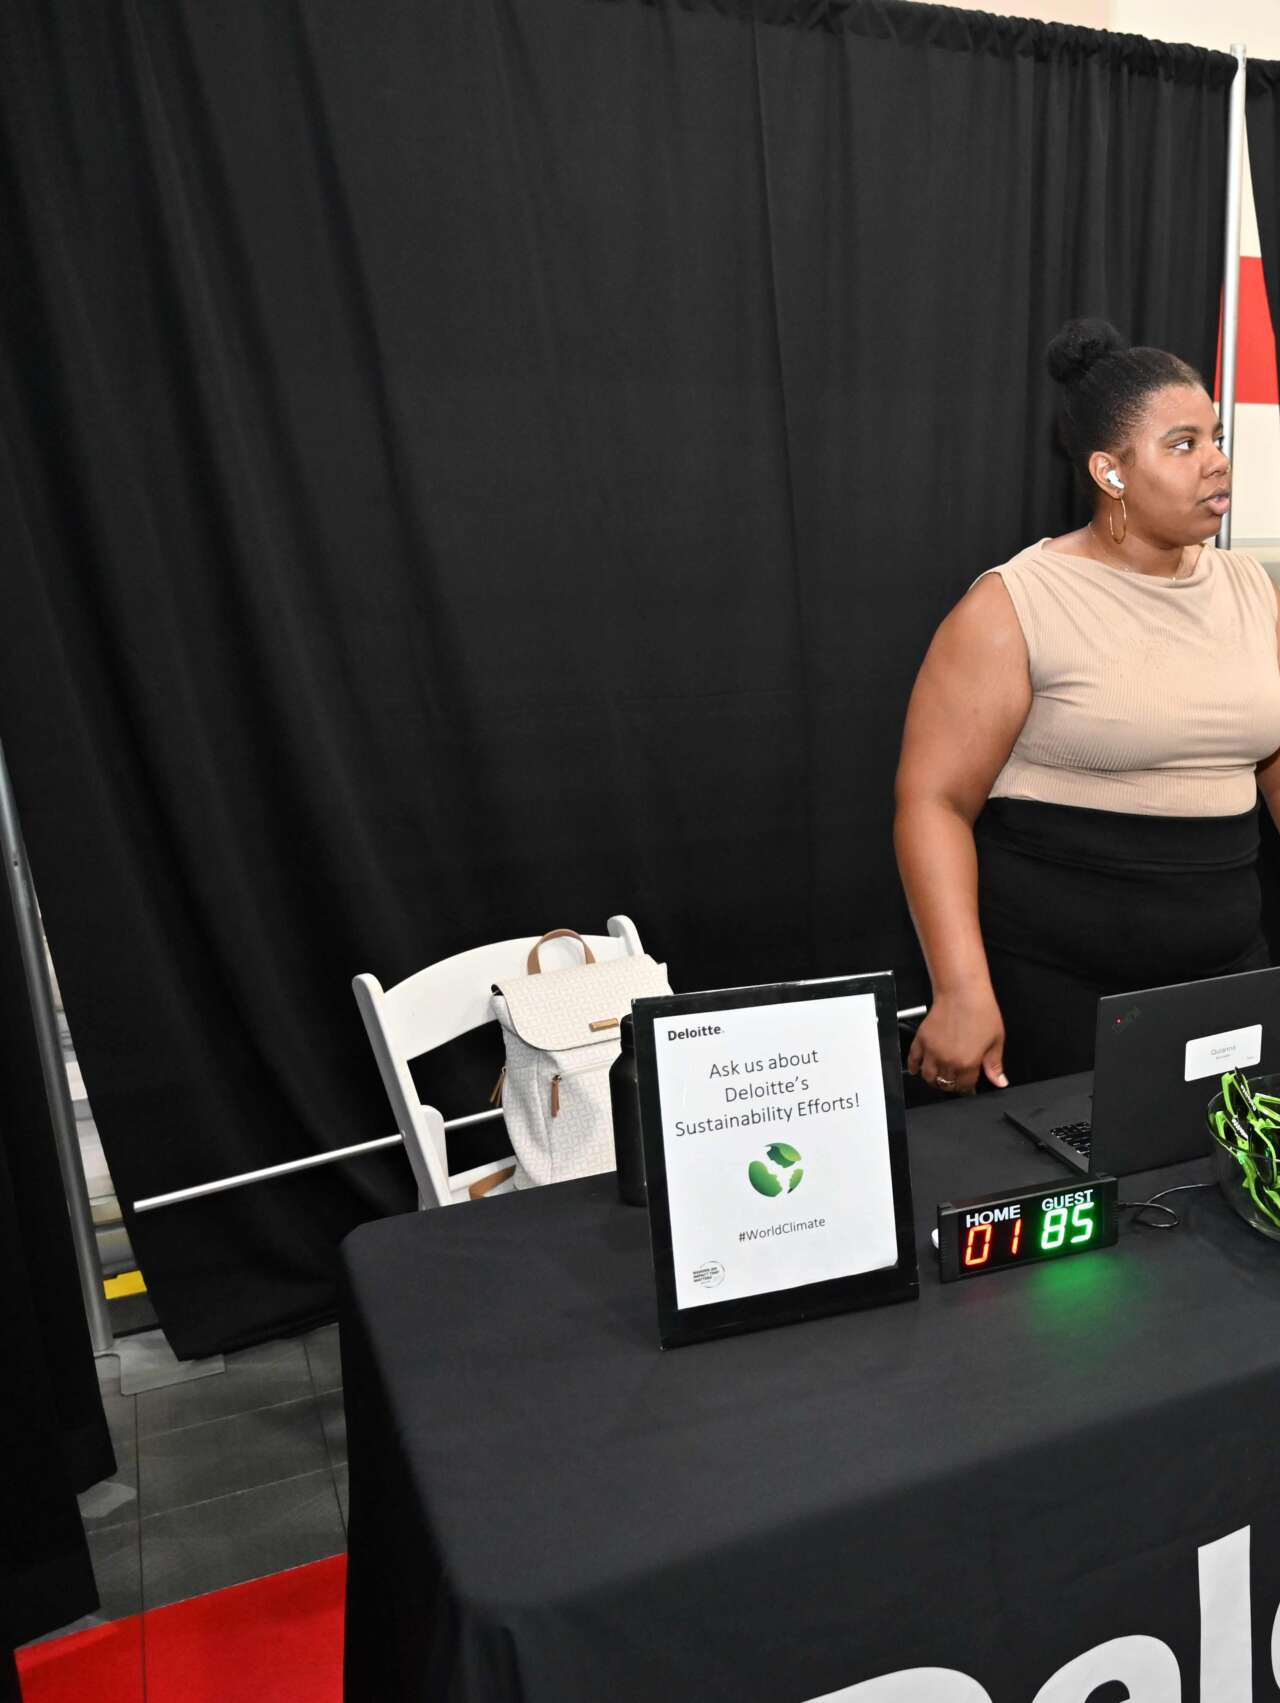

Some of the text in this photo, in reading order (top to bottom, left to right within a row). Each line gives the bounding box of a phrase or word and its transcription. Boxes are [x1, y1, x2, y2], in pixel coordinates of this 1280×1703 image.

[709, 1049, 819, 1079] Ask us about
[725, 1075, 810, 1103] Deloitte's
[675, 1092, 860, 1137] Sustainability Efforts!
[966, 1189, 1094, 1228] HOME GUEST
[738, 1217, 826, 1243] #WorldClimate
[964, 1201, 1095, 1266] 01 85
